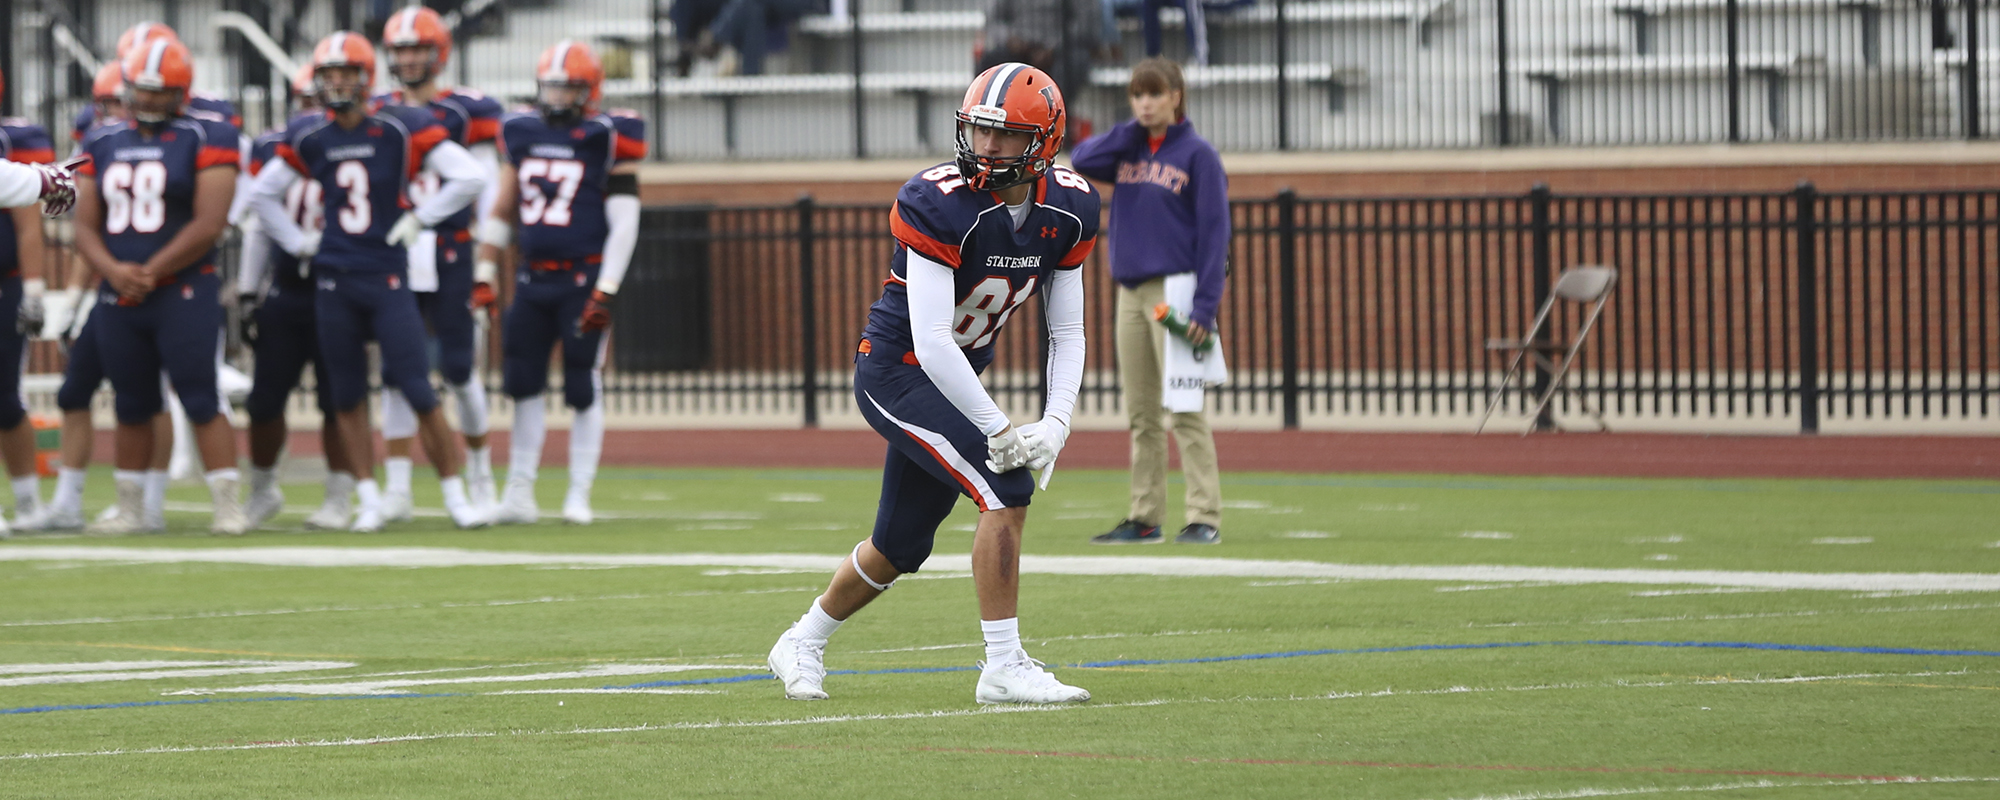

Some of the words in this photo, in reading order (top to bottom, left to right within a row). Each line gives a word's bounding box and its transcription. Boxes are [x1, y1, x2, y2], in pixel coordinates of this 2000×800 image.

[102, 160, 167, 235] 68
[335, 160, 372, 235] 3
[518, 157, 586, 227] 57
[921, 164, 966, 196] 81
[985, 255, 1042, 269] STATESMEN
[952, 274, 1038, 351] 81
